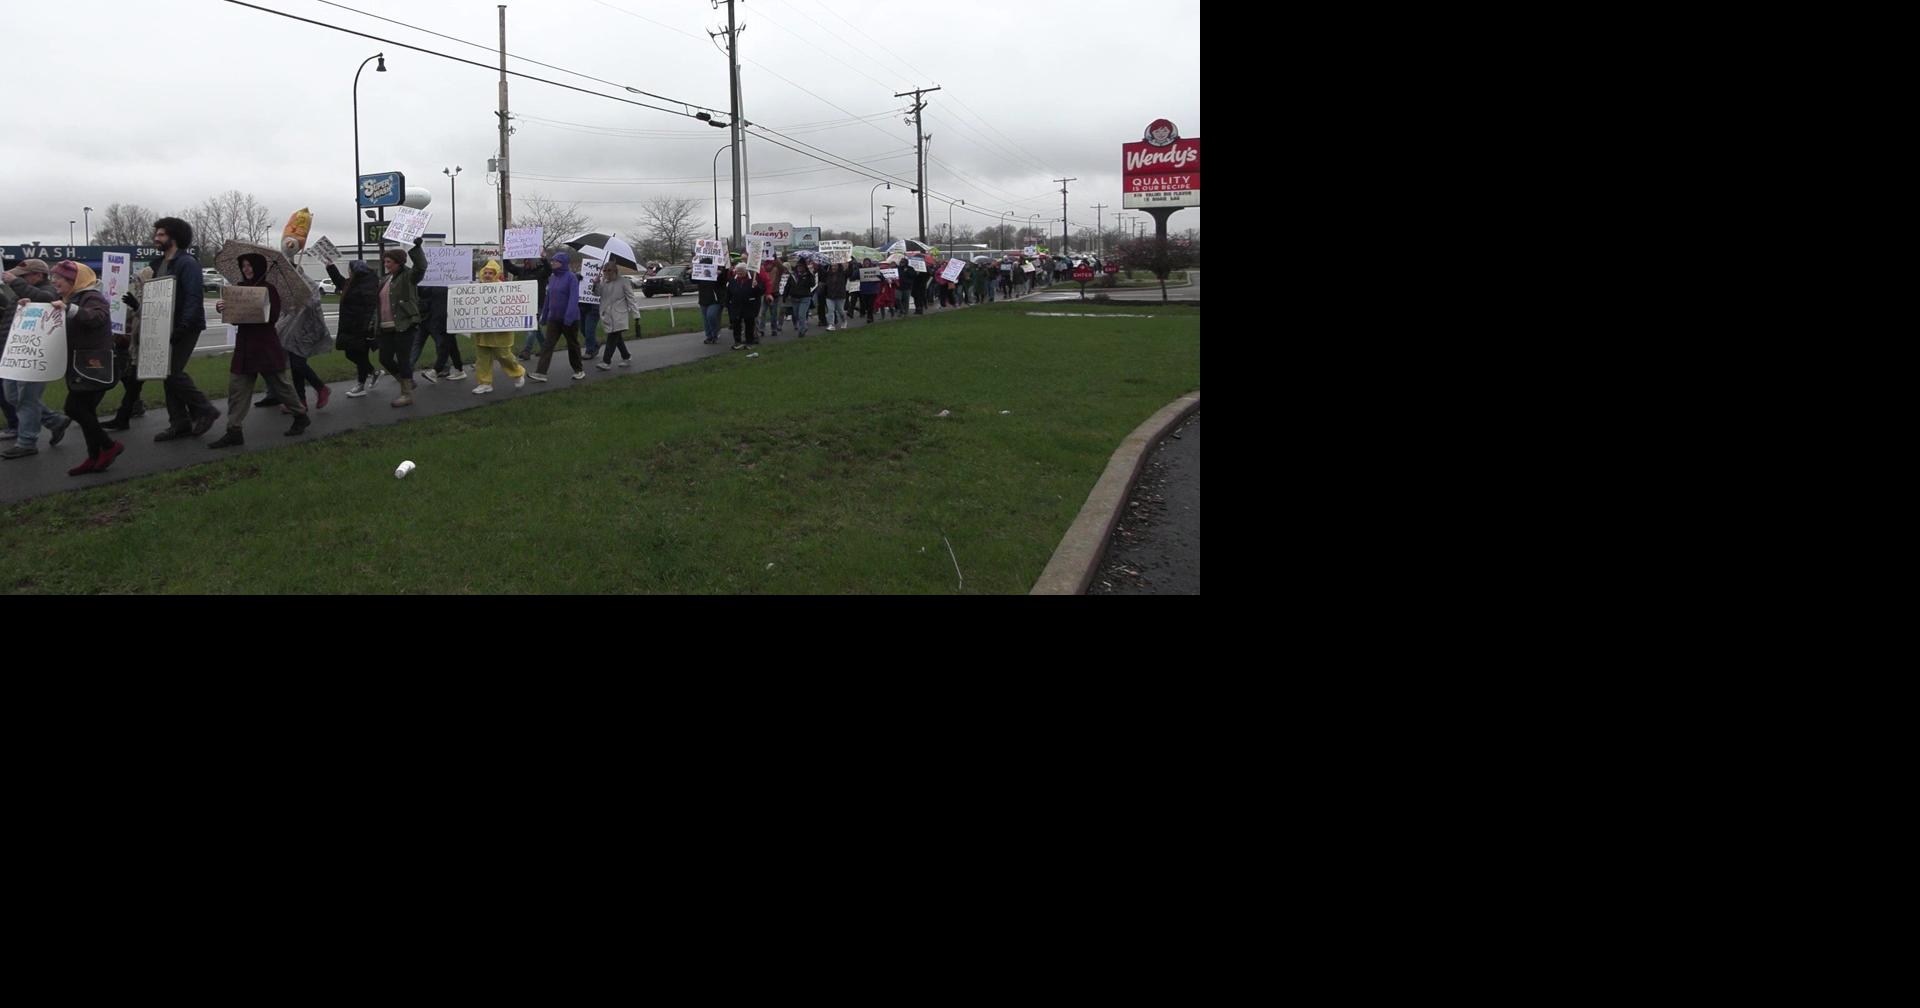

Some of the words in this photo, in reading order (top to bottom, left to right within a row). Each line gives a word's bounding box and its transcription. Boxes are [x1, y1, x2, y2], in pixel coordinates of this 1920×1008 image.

[1127, 144, 1198, 171] Wendy's
[1132, 176, 1191, 186] QUALITY
[22, 247, 76, 258] WASH
[456, 286, 476, 294] ONCE
[480, 286, 496, 294] UPON
[498, 285, 504, 293] A
[453, 297, 464, 306] THE
[465, 296, 480, 306] GOP
[483, 296, 498, 304] WAS
[454, 308, 470, 316] NOW
[482, 307, 488, 315] IS
[453, 317, 476, 329] VOTE
